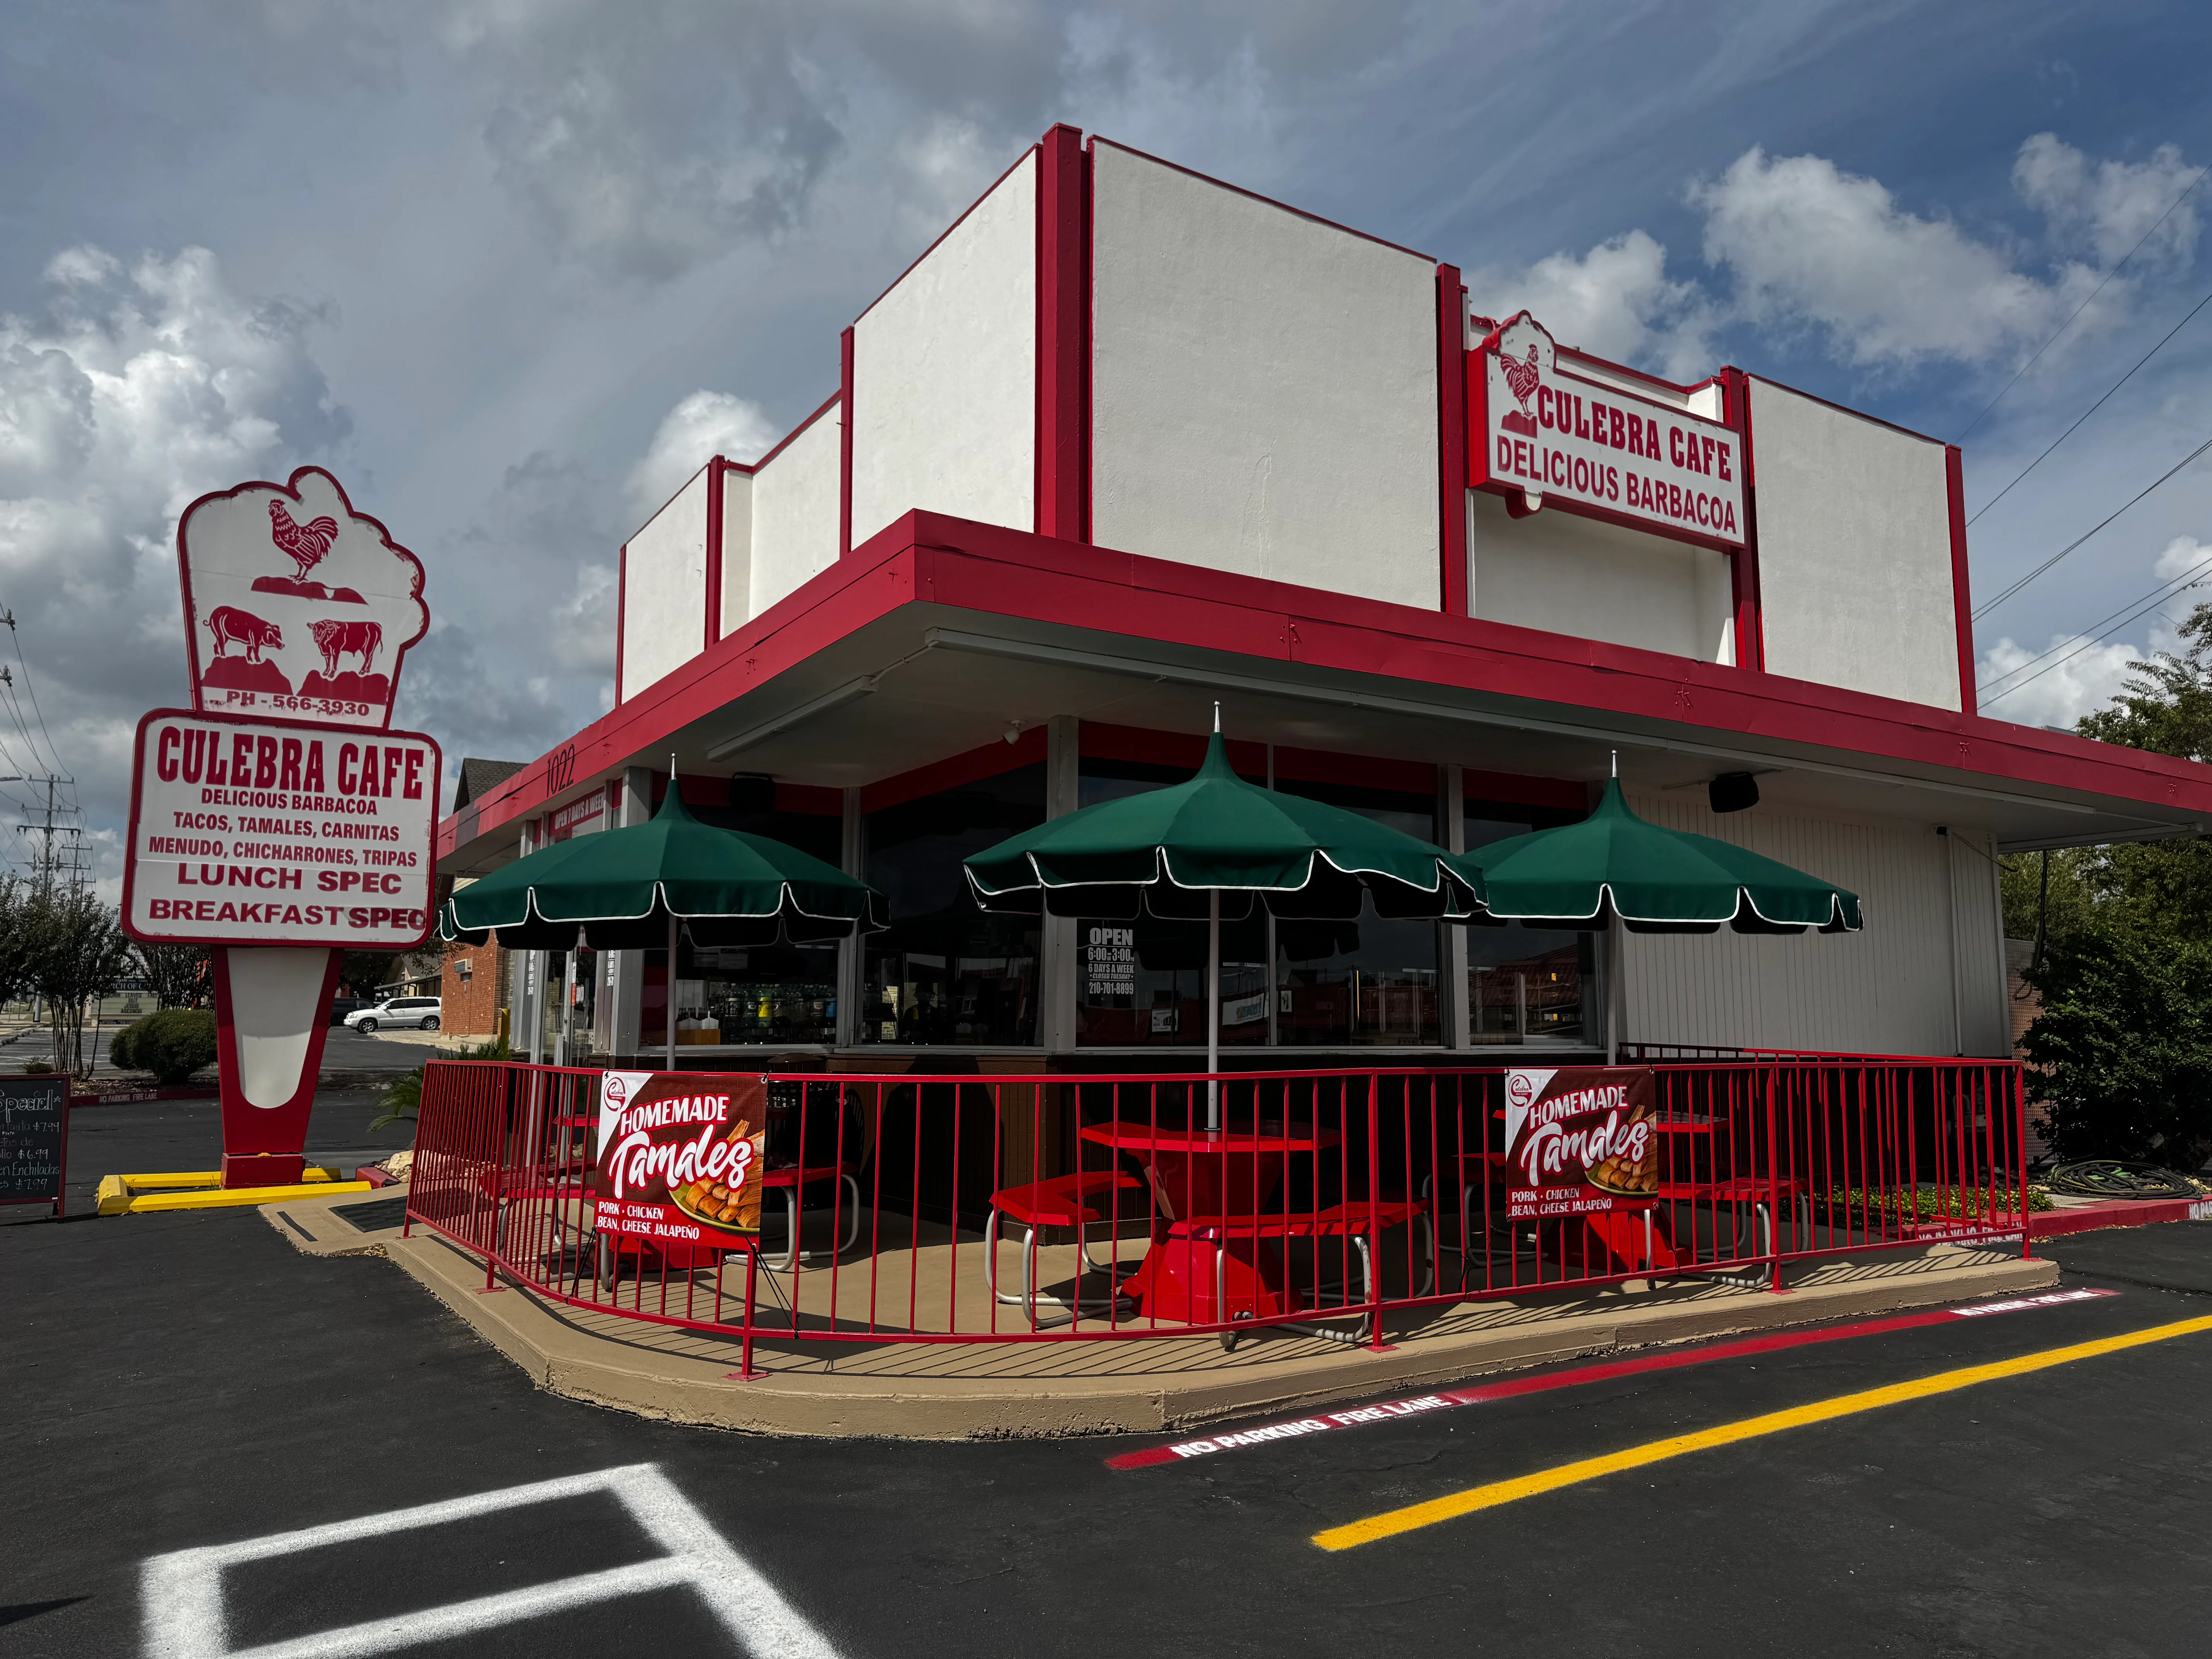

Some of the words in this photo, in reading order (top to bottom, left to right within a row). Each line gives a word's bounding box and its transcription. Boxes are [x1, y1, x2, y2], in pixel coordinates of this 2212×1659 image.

[1537, 385, 1661, 462] CULEBRA
[1669, 426, 1731, 482] CAFE
[1497, 434, 1619, 501] DELICIOUS
[1626, 471, 1737, 534] BARBACOA
[227, 690, 255, 705] PH
[273, 695, 369, 716] 566-3930
[157, 726, 325, 793] CULEBRA
[338, 742, 424, 800] CAFE
[547, 744, 575, 798] 1022
[201, 788, 287, 809] DELICIOUS
[292, 795, 377, 815] BARBACOA
[173, 812, 233, 833] TACOS,
[238, 816, 317, 838] TAMALES,
[322, 822, 399, 842] CARNITAS
[149, 836, 228, 859] MENUDO,
[233, 842, 358, 866] CHICHARRONES,
[363, 849, 417, 867] TRIPAS
[178, 863, 302, 890] LUNCH
[317, 871, 402, 895] SPEC
[149, 899, 344, 926] BREAKFAST
[348, 907, 426, 930] SPEC
[1090, 927, 1133, 946] OPEN
[1088, 963, 1092, 972] 6
[1094, 963, 1110, 973] DAYS
[1111, 964, 1115, 973] A
[1117, 964, 1134, 973] WEEK
[1089, 982, 1133, 994] 210-701-8899
[620, 1096, 729, 1136] HOMEMADE
[1530, 1086, 1628, 1129] HOMEMADE
[609, 1124, 752, 1199] Tamales
[1520, 1110, 1649, 1186] Tamales
[599, 1201, 620, 1215] PORK
[627, 1205, 664, 1220] CHICKEN
[1512, 1191, 1537, 1202] PORK
[1546, 1188, 1579, 1200] CHICKEN
[1512, 1205, 1537, 1216] BEAN,
[1540, 1202, 1569, 1214] CHEESE
[598, 1216, 619, 1231] BEAN,
[622, 1219, 652, 1233] CHEESE
[2189, 1203, 2199, 1220] NO
[1169, 1441, 1217, 1457] NO
[1213, 1419, 1331, 1448] PARKING
[1328, 1407, 1393, 1425] FIRE
[1382, 1396, 1452, 1414] LANE
